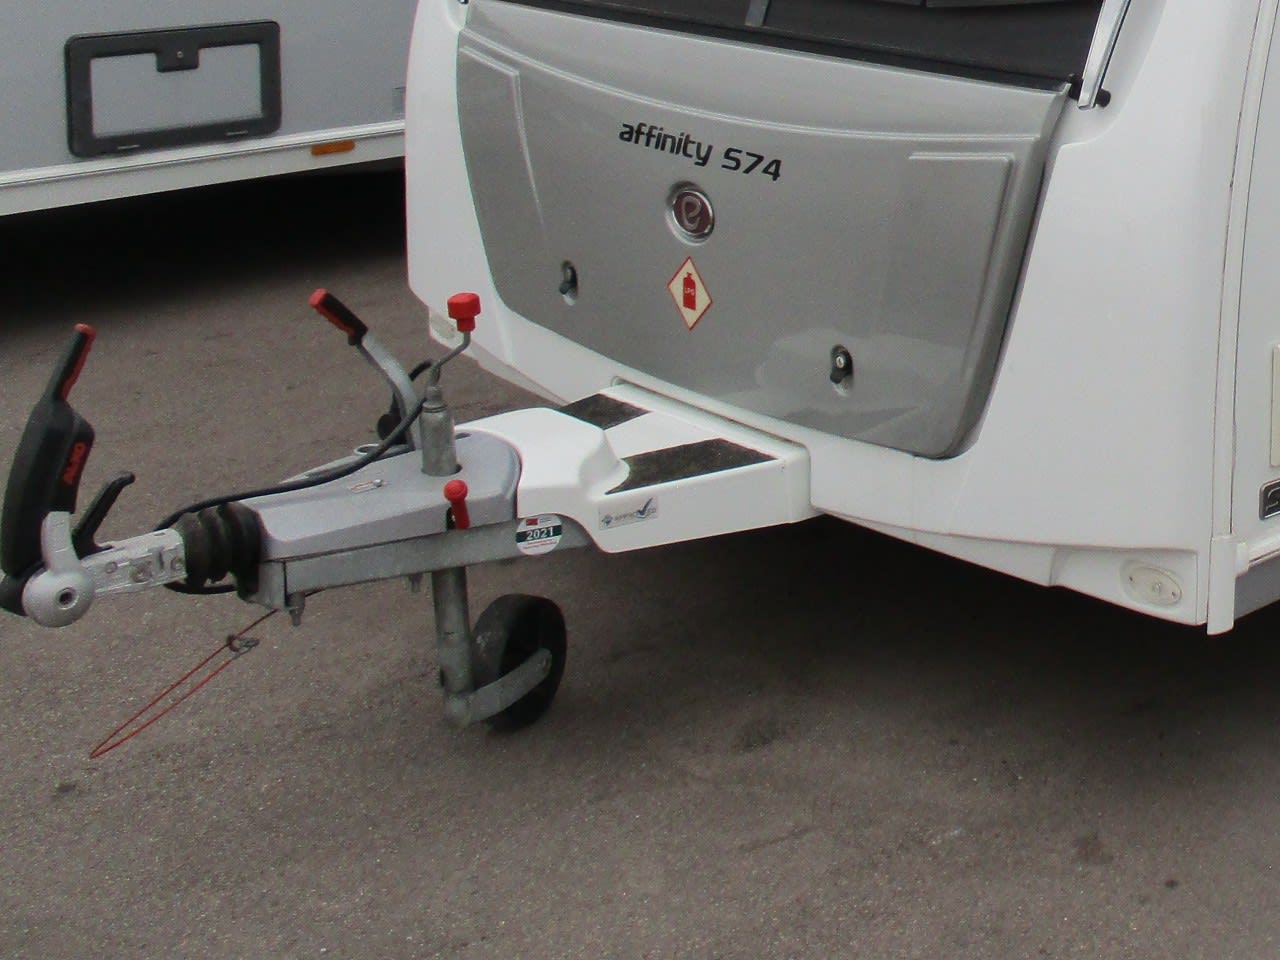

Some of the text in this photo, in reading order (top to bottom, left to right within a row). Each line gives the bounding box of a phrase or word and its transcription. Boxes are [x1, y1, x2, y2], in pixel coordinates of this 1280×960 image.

[619, 122, 782, 182] affinity 574
[526, 526, 554, 541] 2021
